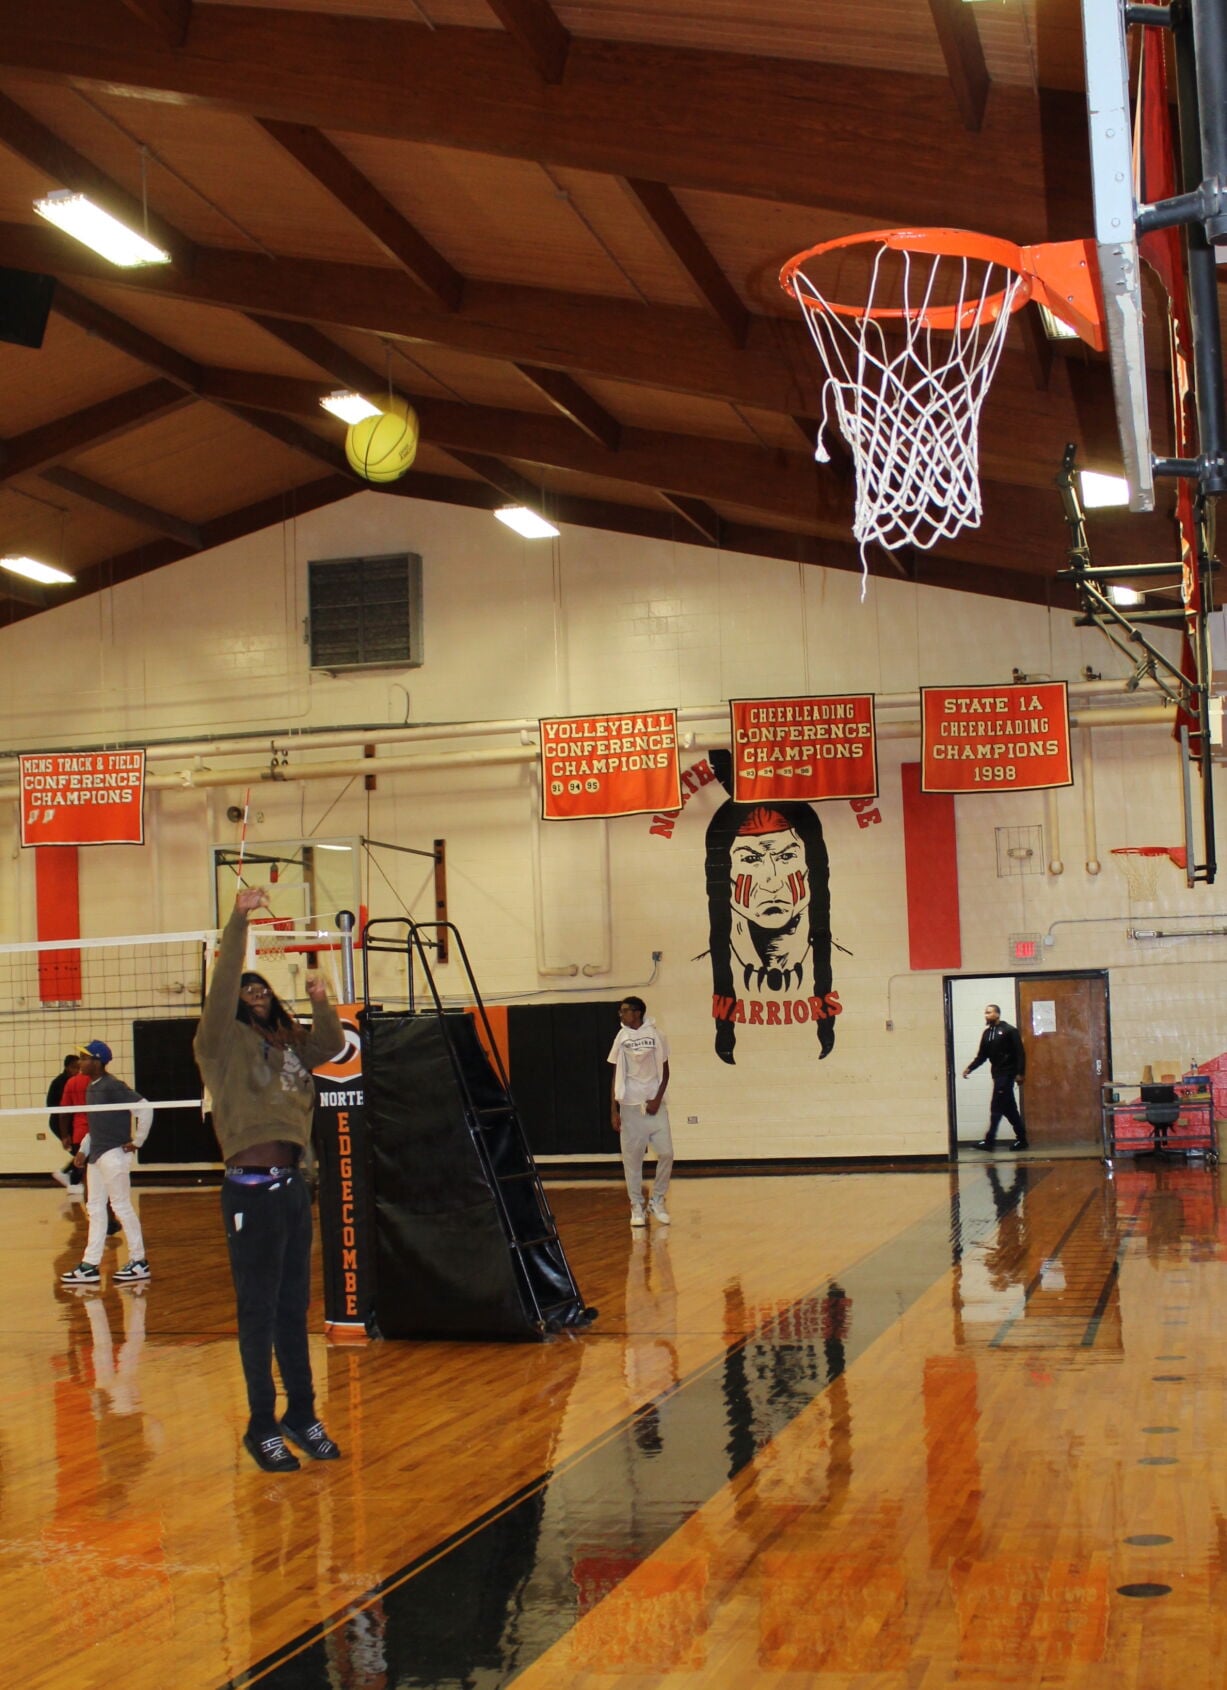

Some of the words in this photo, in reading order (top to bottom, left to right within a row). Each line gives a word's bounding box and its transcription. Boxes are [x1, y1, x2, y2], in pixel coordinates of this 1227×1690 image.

[750, 704, 854, 723] CHEERLEADING
[944, 698, 1009, 713] STATE
[1019, 695, 1043, 711] 1A
[545, 716, 673, 739] VOLLEYBALL
[736, 722, 871, 744] CONFERENCE
[940, 718, 1049, 737] CHEERLEADING
[545, 734, 675, 758] CONFERENCE
[743, 743, 864, 763] CHAMPIONS
[933, 740, 1059, 760] CHAMPIONS
[24, 758, 53, 773] MENS
[57, 756, 93, 772] TRACK
[97, 756, 105, 770] &
[108, 754, 141, 770] FIELD
[551, 752, 669, 777] CHAMPIONS
[974, 765, 1017, 782] 1998
[24, 772, 141, 790] CONFERENCE
[31, 788, 133, 806] CHAMPIONS
[649, 759, 716, 839] NTH
[712, 990, 843, 1025] WARRIORS
[336, 1111, 358, 1316] EDGECOMBE
